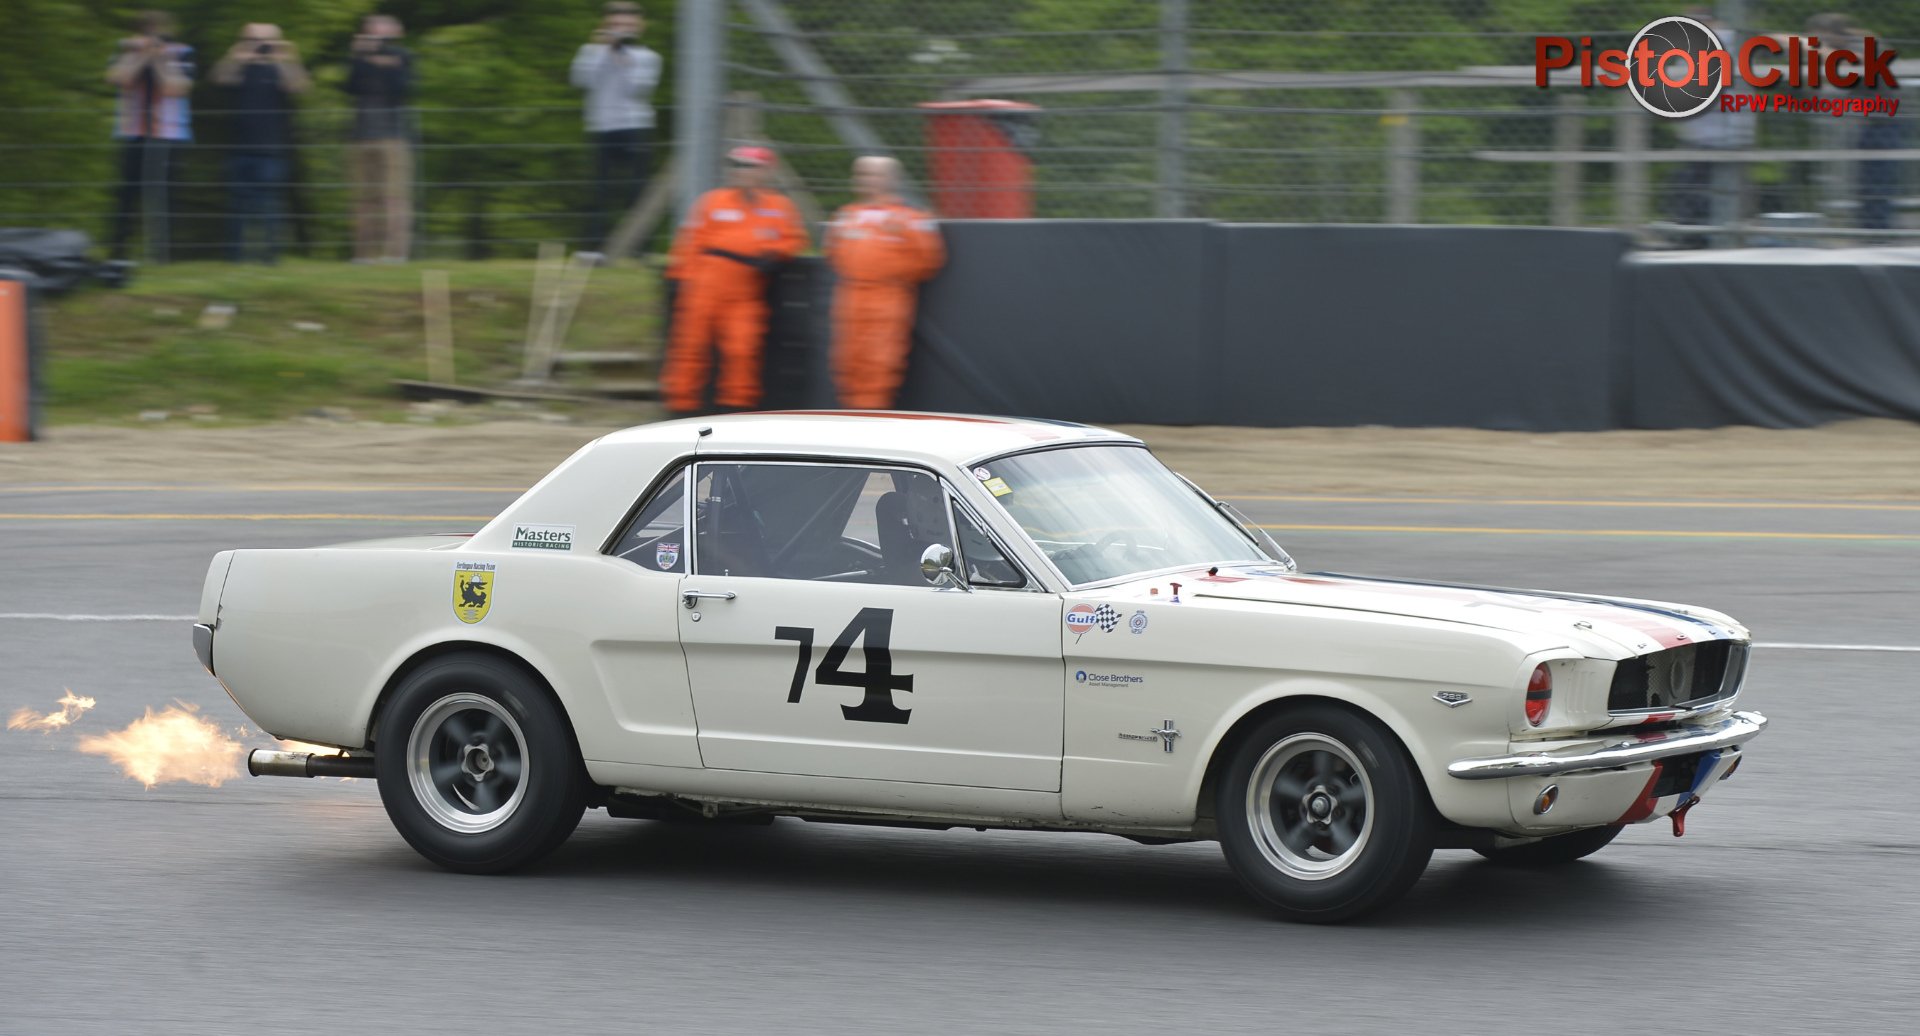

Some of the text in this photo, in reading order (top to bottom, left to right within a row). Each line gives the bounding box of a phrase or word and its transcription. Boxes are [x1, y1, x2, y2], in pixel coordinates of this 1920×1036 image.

[515, 527, 571, 542] Masters
[1067, 613, 1095, 624] Gulf
[775, 607, 914, 725] 74
[1088, 673, 1143, 683] Close Brothers
